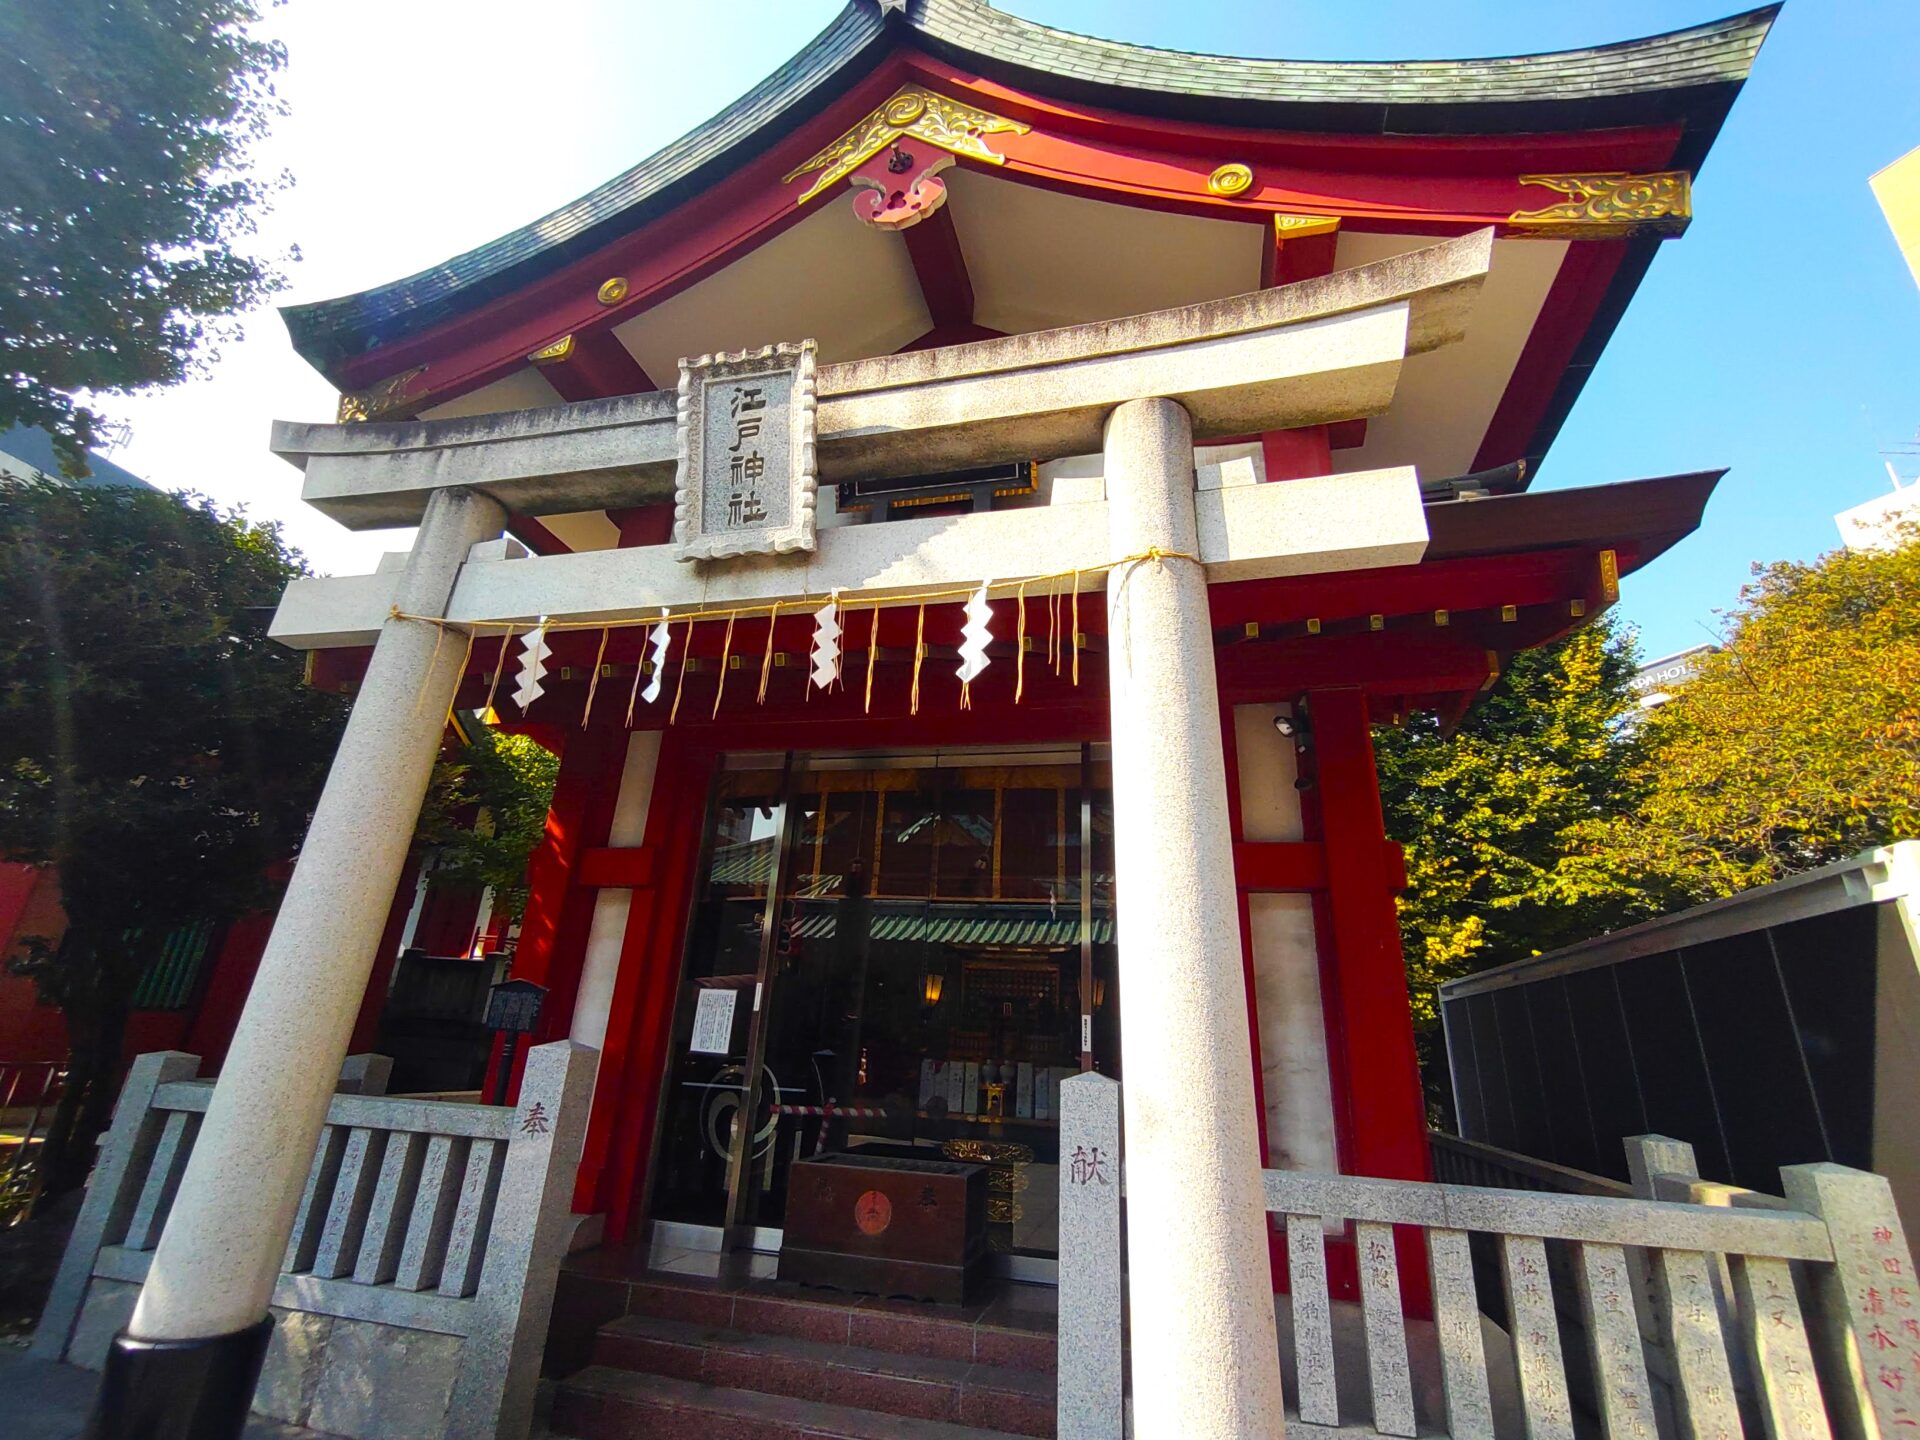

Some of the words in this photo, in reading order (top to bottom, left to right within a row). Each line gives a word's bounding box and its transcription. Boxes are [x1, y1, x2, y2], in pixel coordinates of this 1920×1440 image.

[728, 387, 768, 526] 江戸神社
[520, 1101, 549, 1139] 奉
[1070, 1145, 1112, 1186] 献
